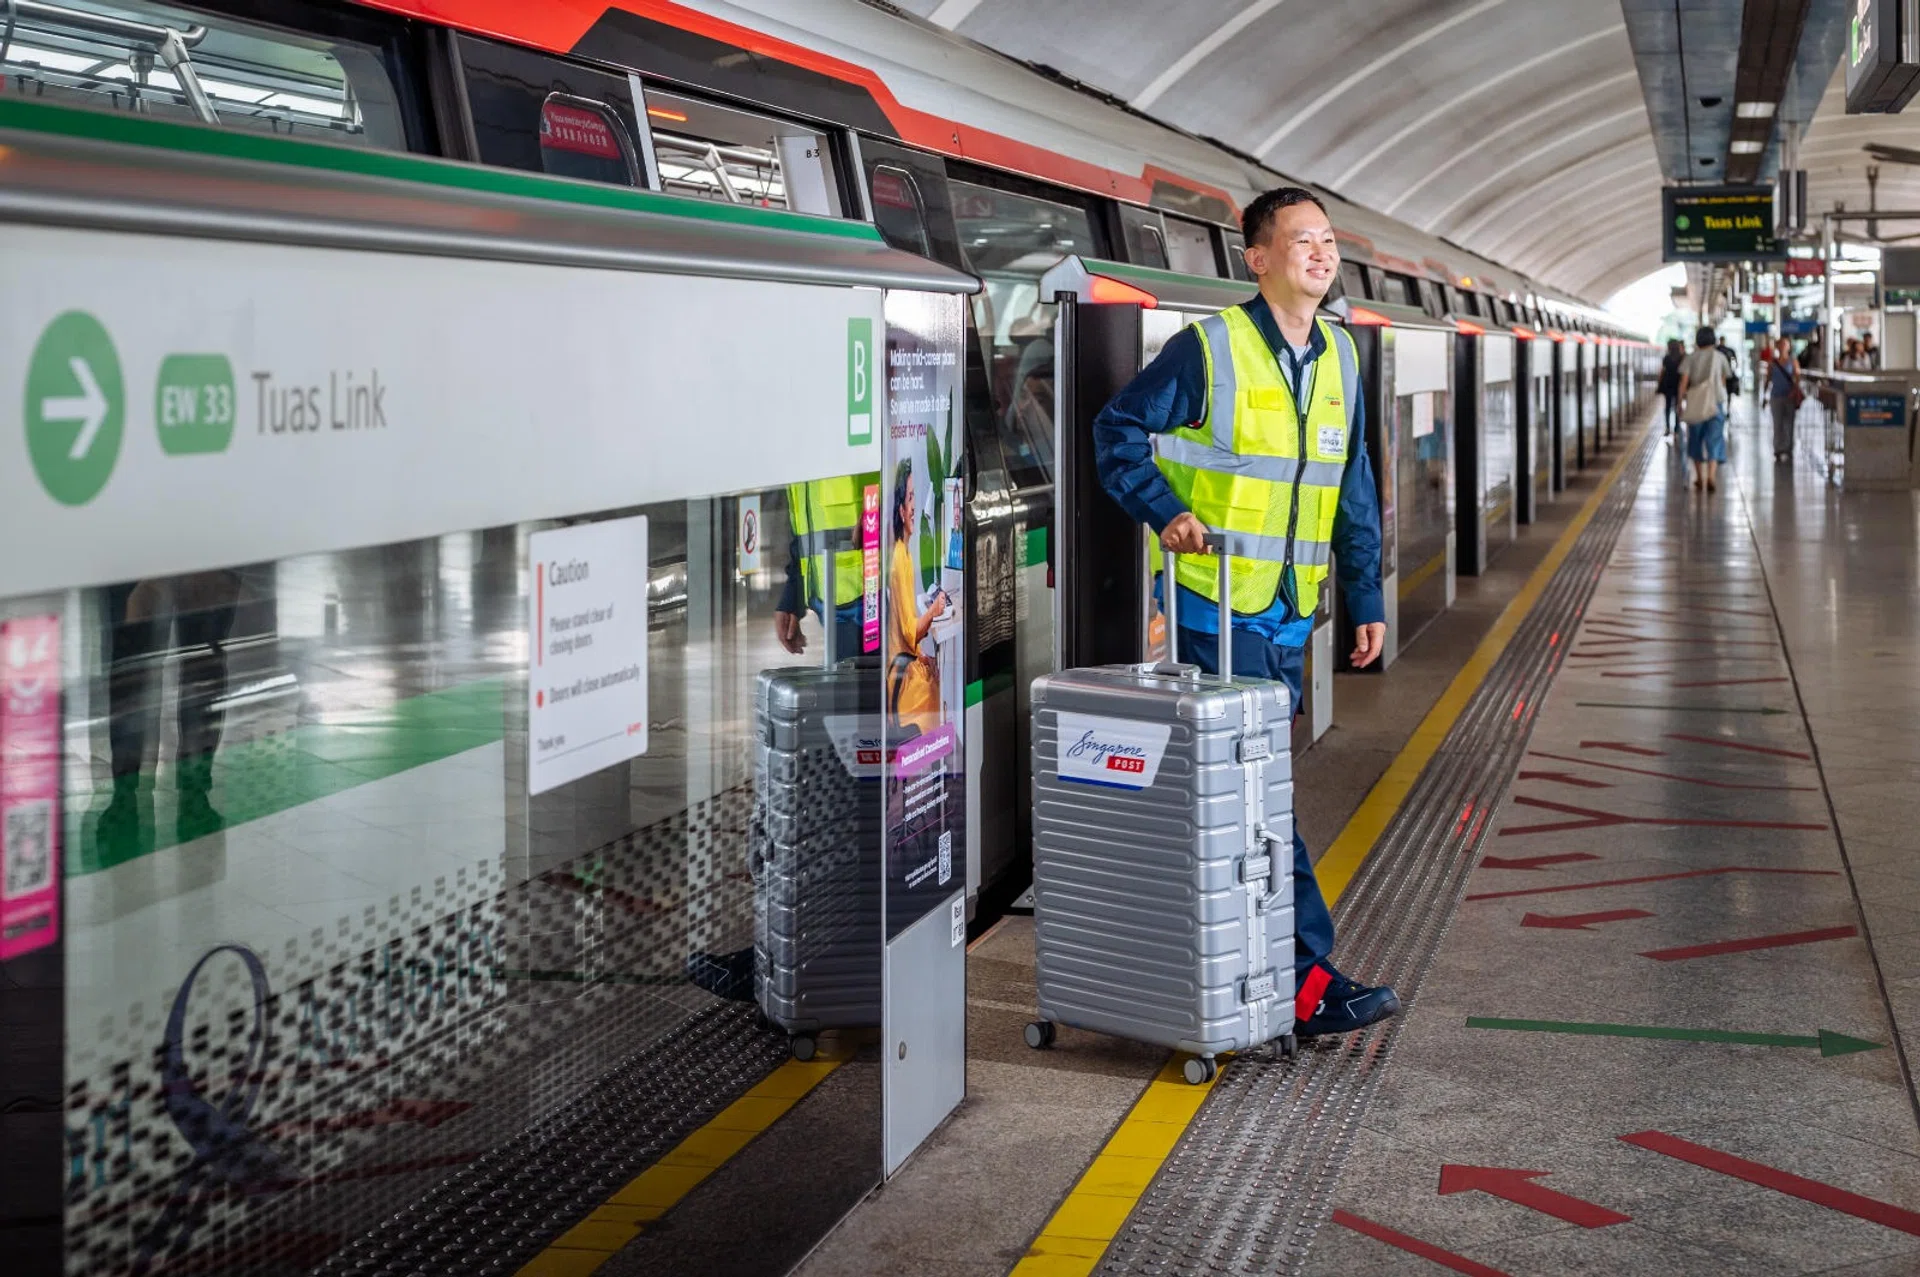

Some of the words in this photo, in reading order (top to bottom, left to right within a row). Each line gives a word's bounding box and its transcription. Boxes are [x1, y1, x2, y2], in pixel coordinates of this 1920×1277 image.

[1703, 215, 1733, 229] Tuas
[1735, 215, 1763, 229] Link
[854, 340, 866, 402] B
[890, 348, 911, 372] Making
[912, 348, 941, 366] mid-career
[941, 349, 956, 371] plans
[890, 376, 901, 391] can
[902, 373, 910, 390] be
[162, 385, 196, 425] EW
[203, 384, 231, 424] 33
[252, 372, 321, 434] Tuas
[329, 368, 387, 431] Link
[890, 420, 907, 439] easier
[549, 558, 589, 587] Caution
[1067, 730, 1147, 764] Singapore
[1114, 759, 1141, 770] POST
